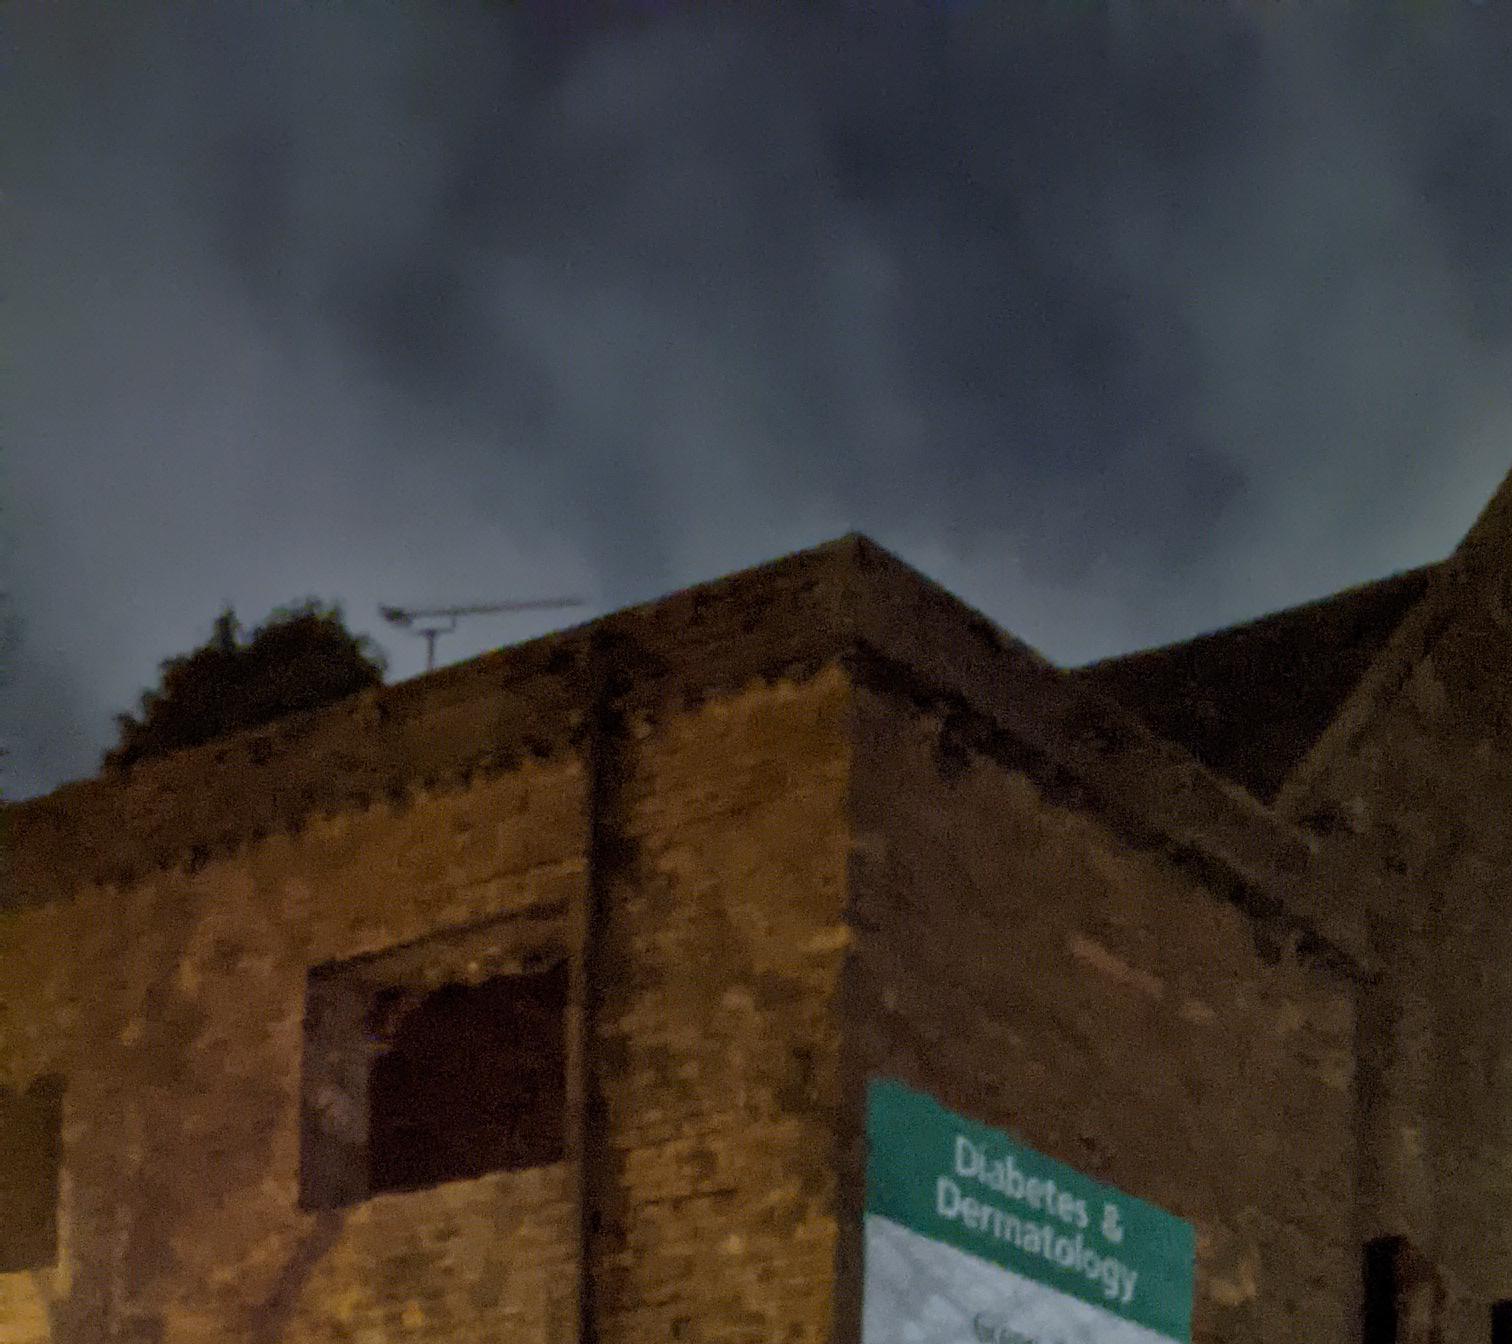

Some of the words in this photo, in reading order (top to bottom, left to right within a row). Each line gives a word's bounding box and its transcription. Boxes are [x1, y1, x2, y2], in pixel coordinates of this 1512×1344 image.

[936, 1175, 1139, 1304] Dermatology
[954, 1135, 1090, 1229] Diabetes
[1102, 1203, 1124, 1245] &
